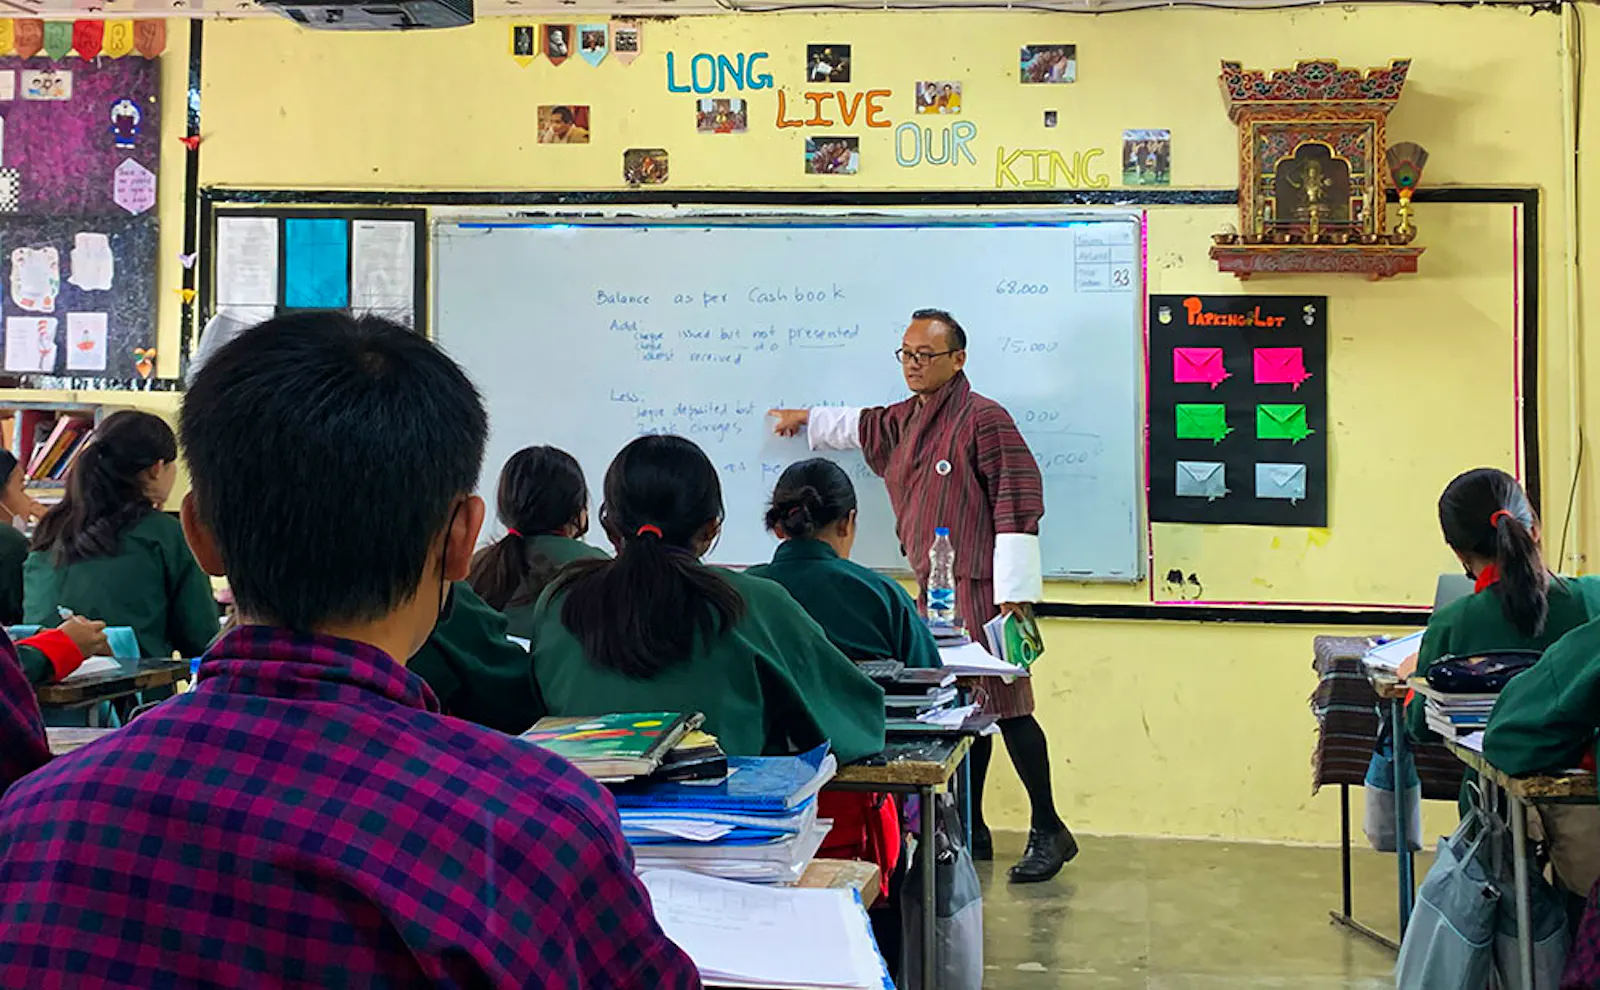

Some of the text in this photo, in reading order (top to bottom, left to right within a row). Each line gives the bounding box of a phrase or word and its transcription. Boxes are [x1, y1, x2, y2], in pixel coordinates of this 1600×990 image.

[667, 51, 1109, 188] LONG LIVE OUR KING
[1113, 267, 1130, 287] 23
[596, 289, 651, 306] Balance
[674, 293, 694, 304] as
[703, 290, 728, 308] per
